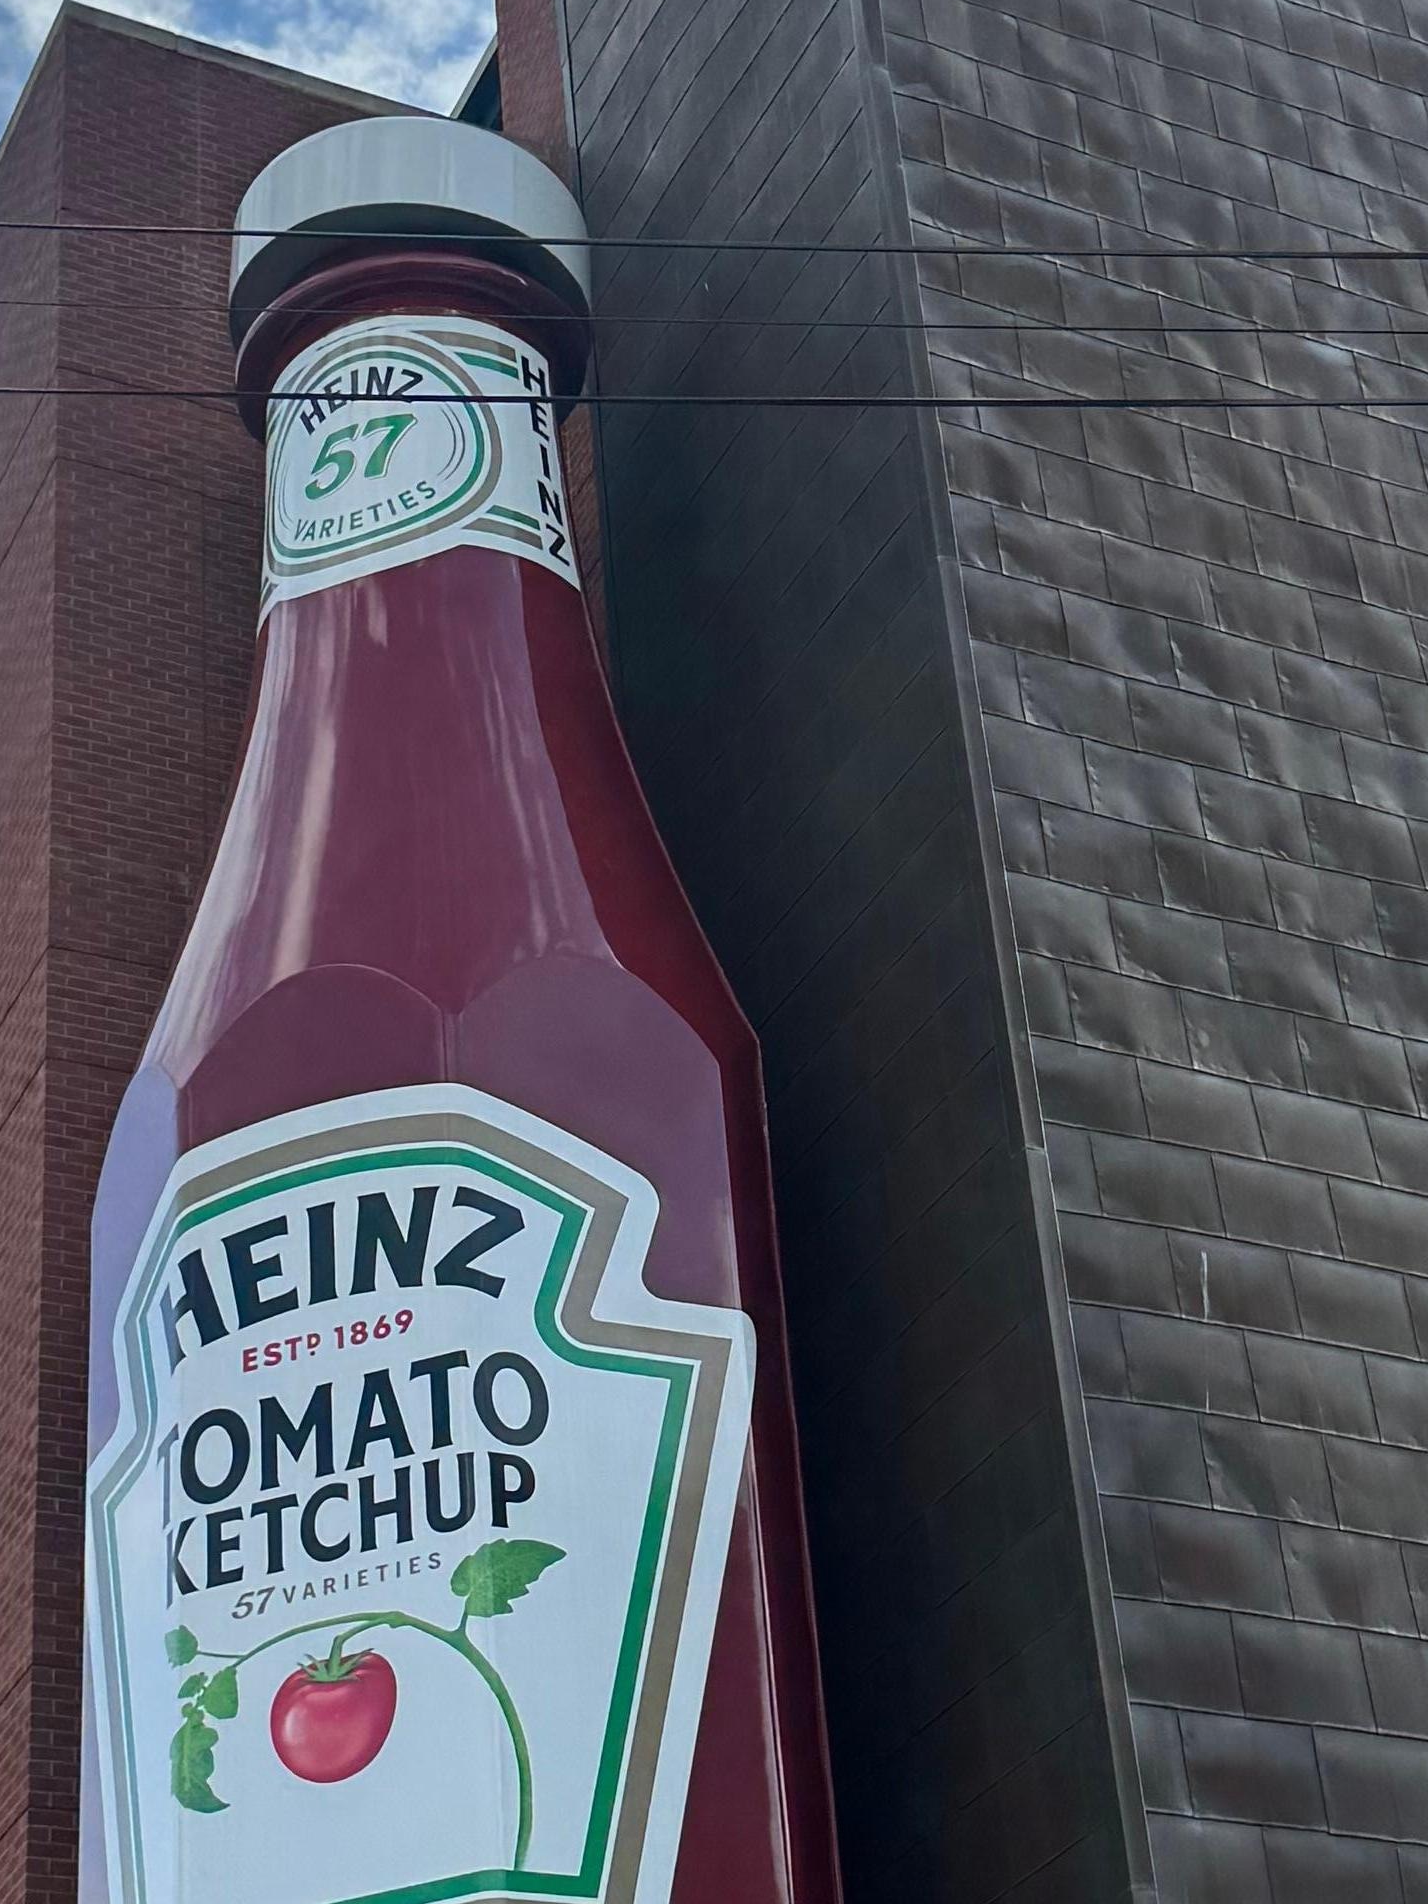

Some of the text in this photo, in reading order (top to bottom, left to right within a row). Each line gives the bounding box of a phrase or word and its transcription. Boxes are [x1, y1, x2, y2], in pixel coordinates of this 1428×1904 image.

[300, 366, 424, 435] HEINZ
[304, 413, 419, 501] 57
[520, 355, 571, 567] HEINZ
[292, 480, 437, 543] VARIETIES
[160, 1186, 524, 1376] HEINZ
[334, 1309, 413, 1349] 1869
[158, 1349, 550, 1531] TOMATO
[166, 1451, 536, 1609] KETCHUP
[231, 1552, 442, 1620] 57 VARIETIES
